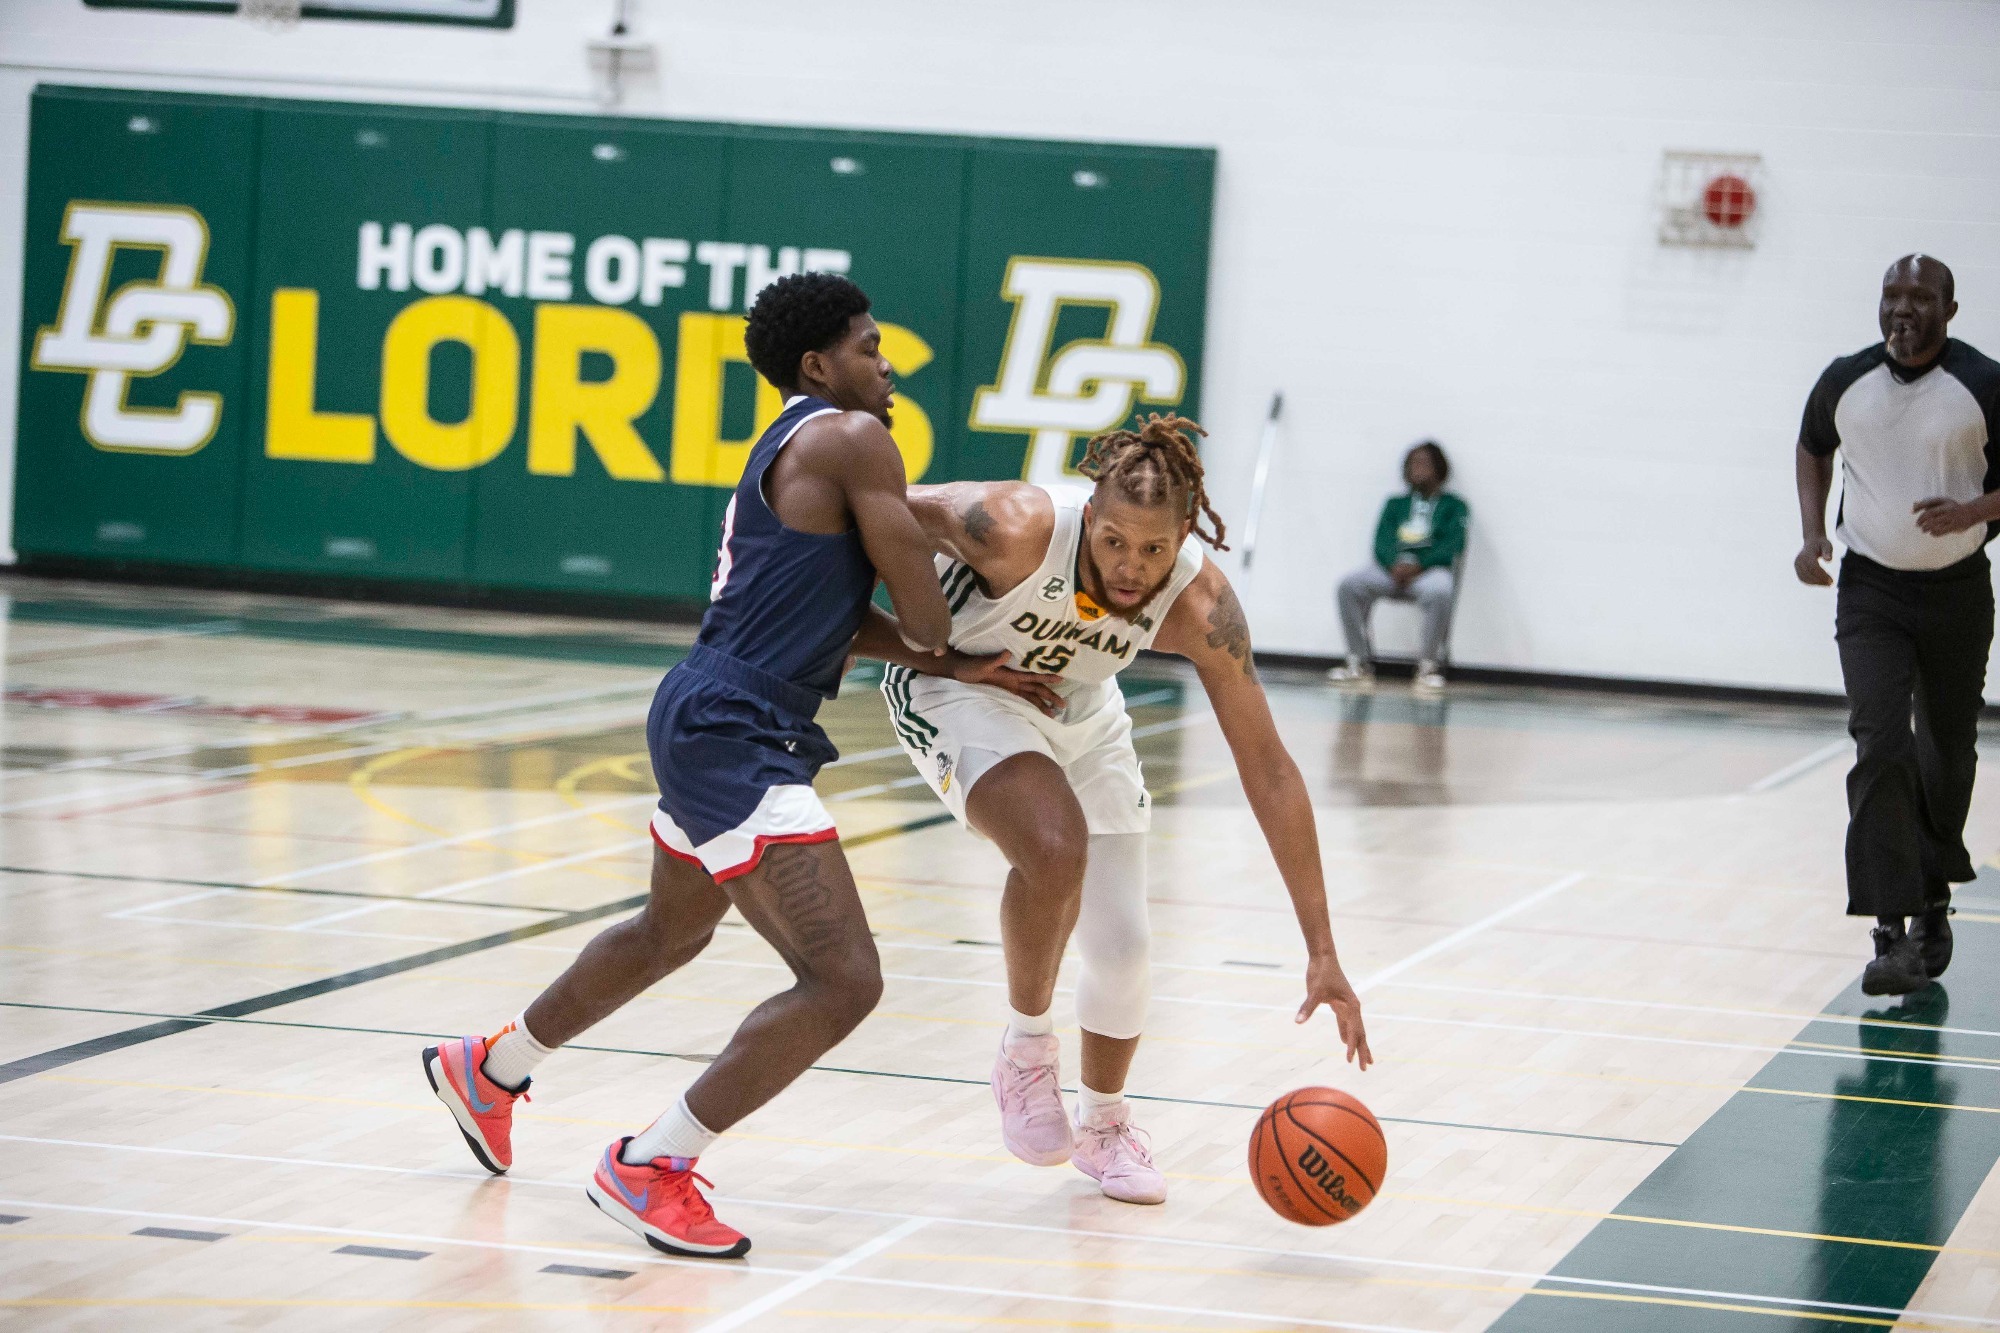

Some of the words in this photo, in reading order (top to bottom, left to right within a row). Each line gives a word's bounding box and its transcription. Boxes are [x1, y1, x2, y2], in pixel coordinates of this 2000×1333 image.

[357, 220, 577, 300] HOME
[585, 234, 692, 306] OF
[1020, 644, 1076, 673] 15
